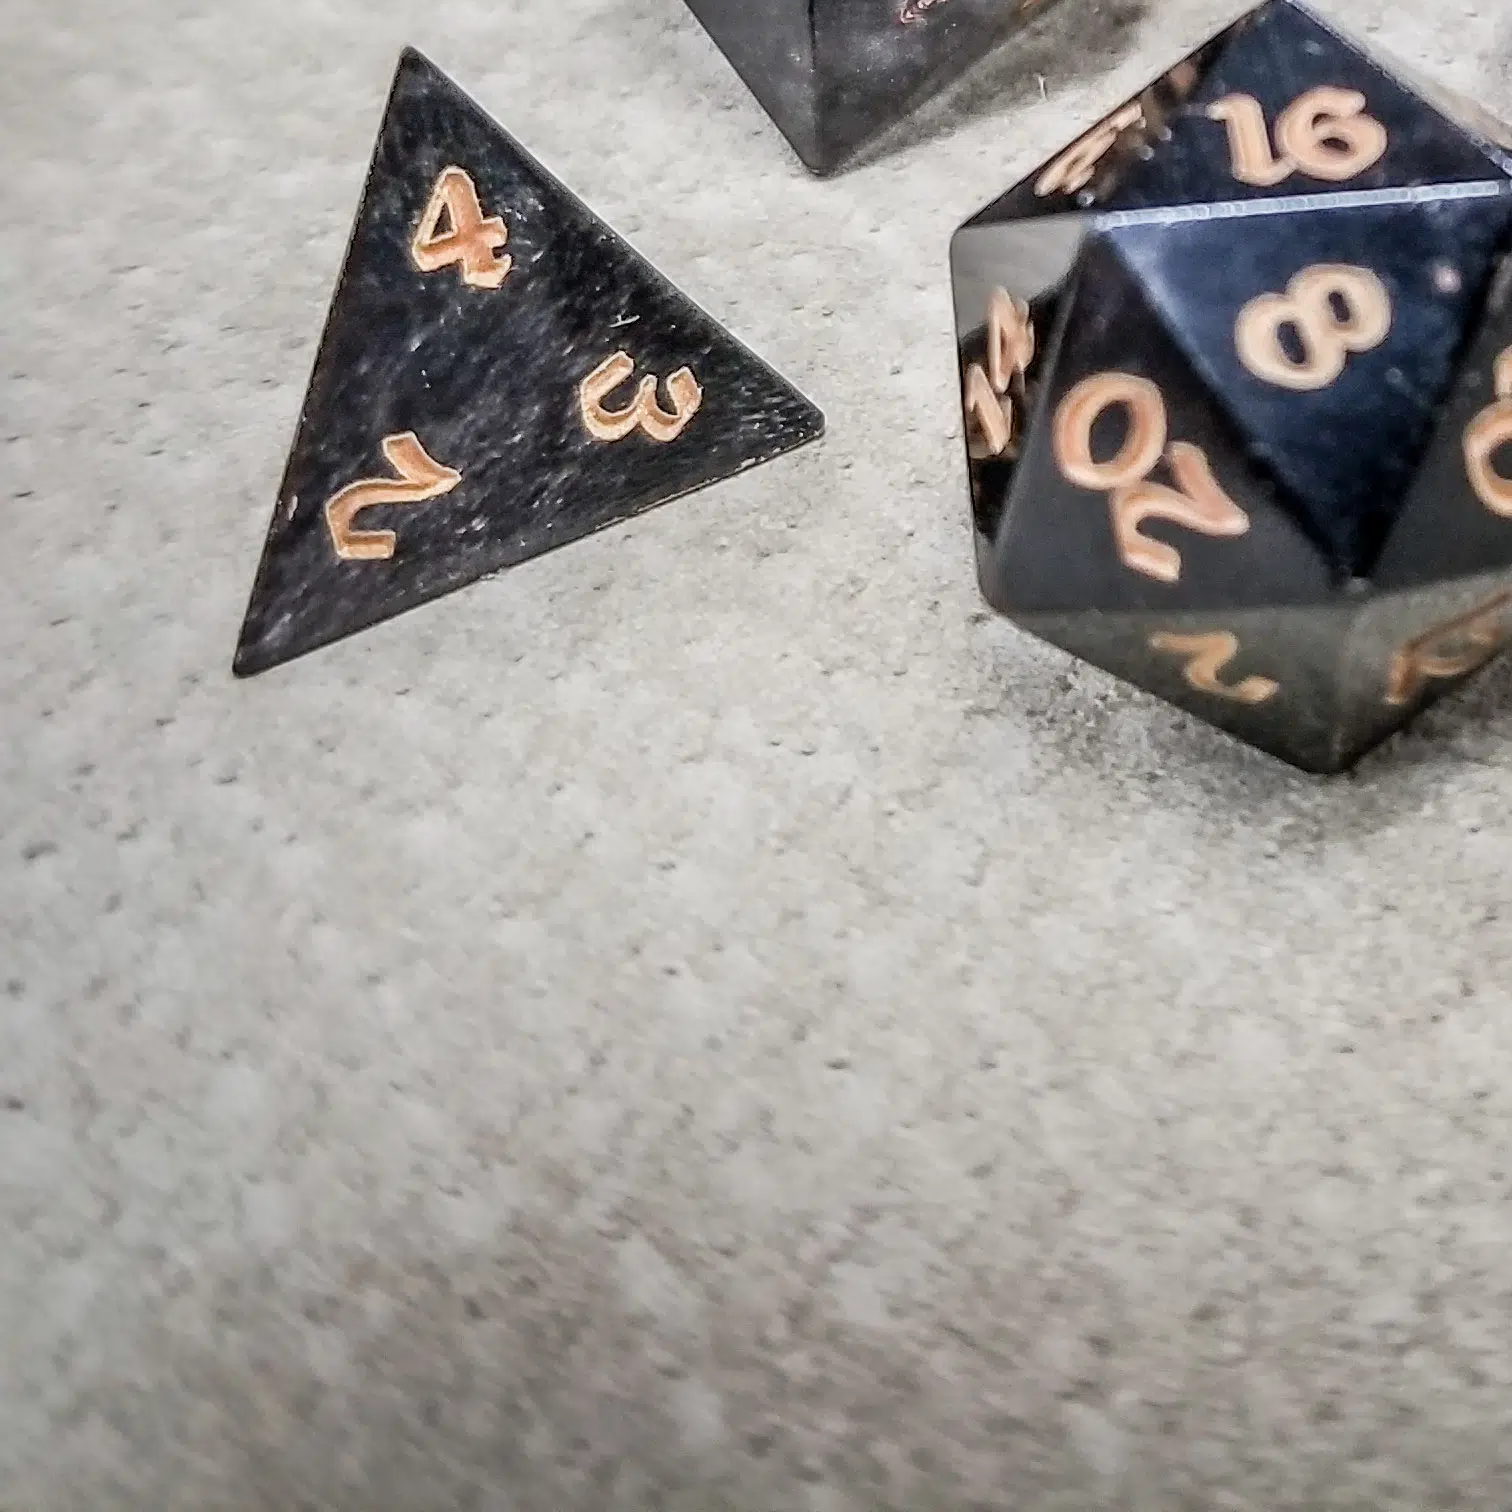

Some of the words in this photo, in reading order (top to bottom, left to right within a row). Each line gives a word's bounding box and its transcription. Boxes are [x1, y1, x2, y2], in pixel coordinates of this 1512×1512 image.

[1205, 85, 1389, 187] 16
[412, 164, 513, 289] 4
[1234, 262, 1395, 390] 8
[579, 349, 703, 443] 3
[324, 430, 464, 560] 2
[1052, 370, 1251, 584] 20
[1147, 628, 1281, 704] 2
